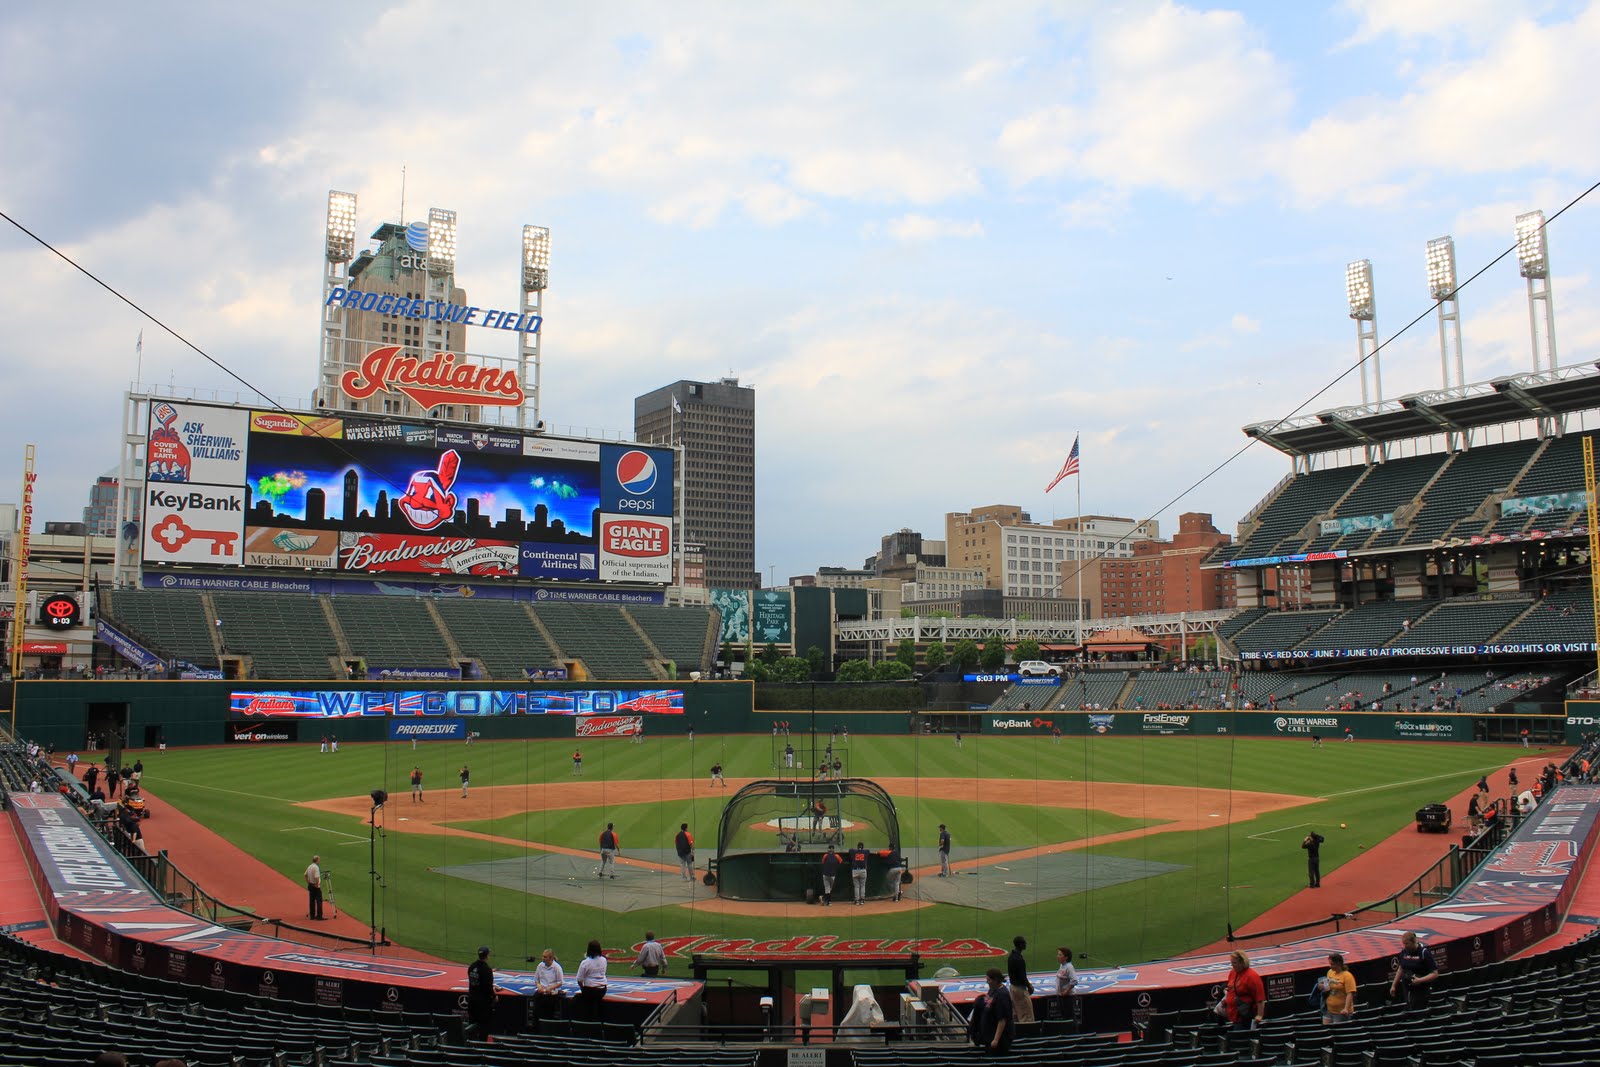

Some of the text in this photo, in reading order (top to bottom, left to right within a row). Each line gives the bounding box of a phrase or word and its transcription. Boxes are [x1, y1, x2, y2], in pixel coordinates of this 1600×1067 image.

[401, 254, 426, 270] at&
[326, 287, 543, 333] PROGRESSIVE FIELD
[341, 346, 524, 408] Indians
[183, 422, 204, 434] ASK
[254, 417, 299, 431] Sugardale
[187, 434, 236, 448] SHERWIN-
[346, 430, 403, 440] MAGAZINE
[406, 434, 427, 442] STO
[489, 437, 520, 445] WEEKNIGHTS
[153, 441, 178, 449] COVER
[153, 452, 177, 460] EARTH
[192, 447, 241, 461] WILLIAMS
[150, 490, 242, 511] KeyBank
[619, 498, 655, 511] pepsi
[20, 473, 37, 568] WALGREENS
[609, 525, 663, 539] GIANT
[610, 538, 662, 552] EAGLE
[340, 537, 476, 569] Budweiser
[456, 551, 516, 568] American Lager
[522, 550, 578, 560] Continental
[251, 554, 332, 567] Medical Mutual
[541, 560, 578, 569] Airlines
[602, 559, 669, 570] Official supermarket
[632, 570, 660, 578] Indians.
[178, 578, 310, 590] TIME WARNER CABLE Bleachers
[550, 591, 652, 602] TIME WARNER CABLE Bleachers
[52, 617, 70, 625] 6:03
[104, 628, 145, 659] TIME WARNER CABLE
[1241, 651, 1260, 659] TRIBE
[1277, 651, 1291, 659] RED
[1293, 650, 1309, 658] SOX
[1314, 650, 1334, 658] JUNE
[1346, 649, 1366, 657] JUNE
[1369, 648, 1378, 656] 10
[1380, 648, 1392, 656] AT
[1392, 646, 1450, 656] PROGRESSIVE
[1452, 646, 1476, 654] FIELD
[1484, 644, 1543, 654] 216.420.HITS
[1545, 643, 1561, 652] OR
[1563, 642, 1589, 652] VISIT
[244, 698, 297, 716] Indians
[317, 691, 618, 717] WELCOME TO
[632, 696, 672, 711] Indians
[577, 716, 635, 735] Budweiser
[993, 720, 1032, 729] KeyBank
[1143, 714, 1190, 724] FirstEnergy
[1305, 718, 1338, 726] WARNER
[1566, 717, 1594, 725] STO
[396, 724, 458, 735] PROGRESSIVE
[855, 853, 865, 861] 22
